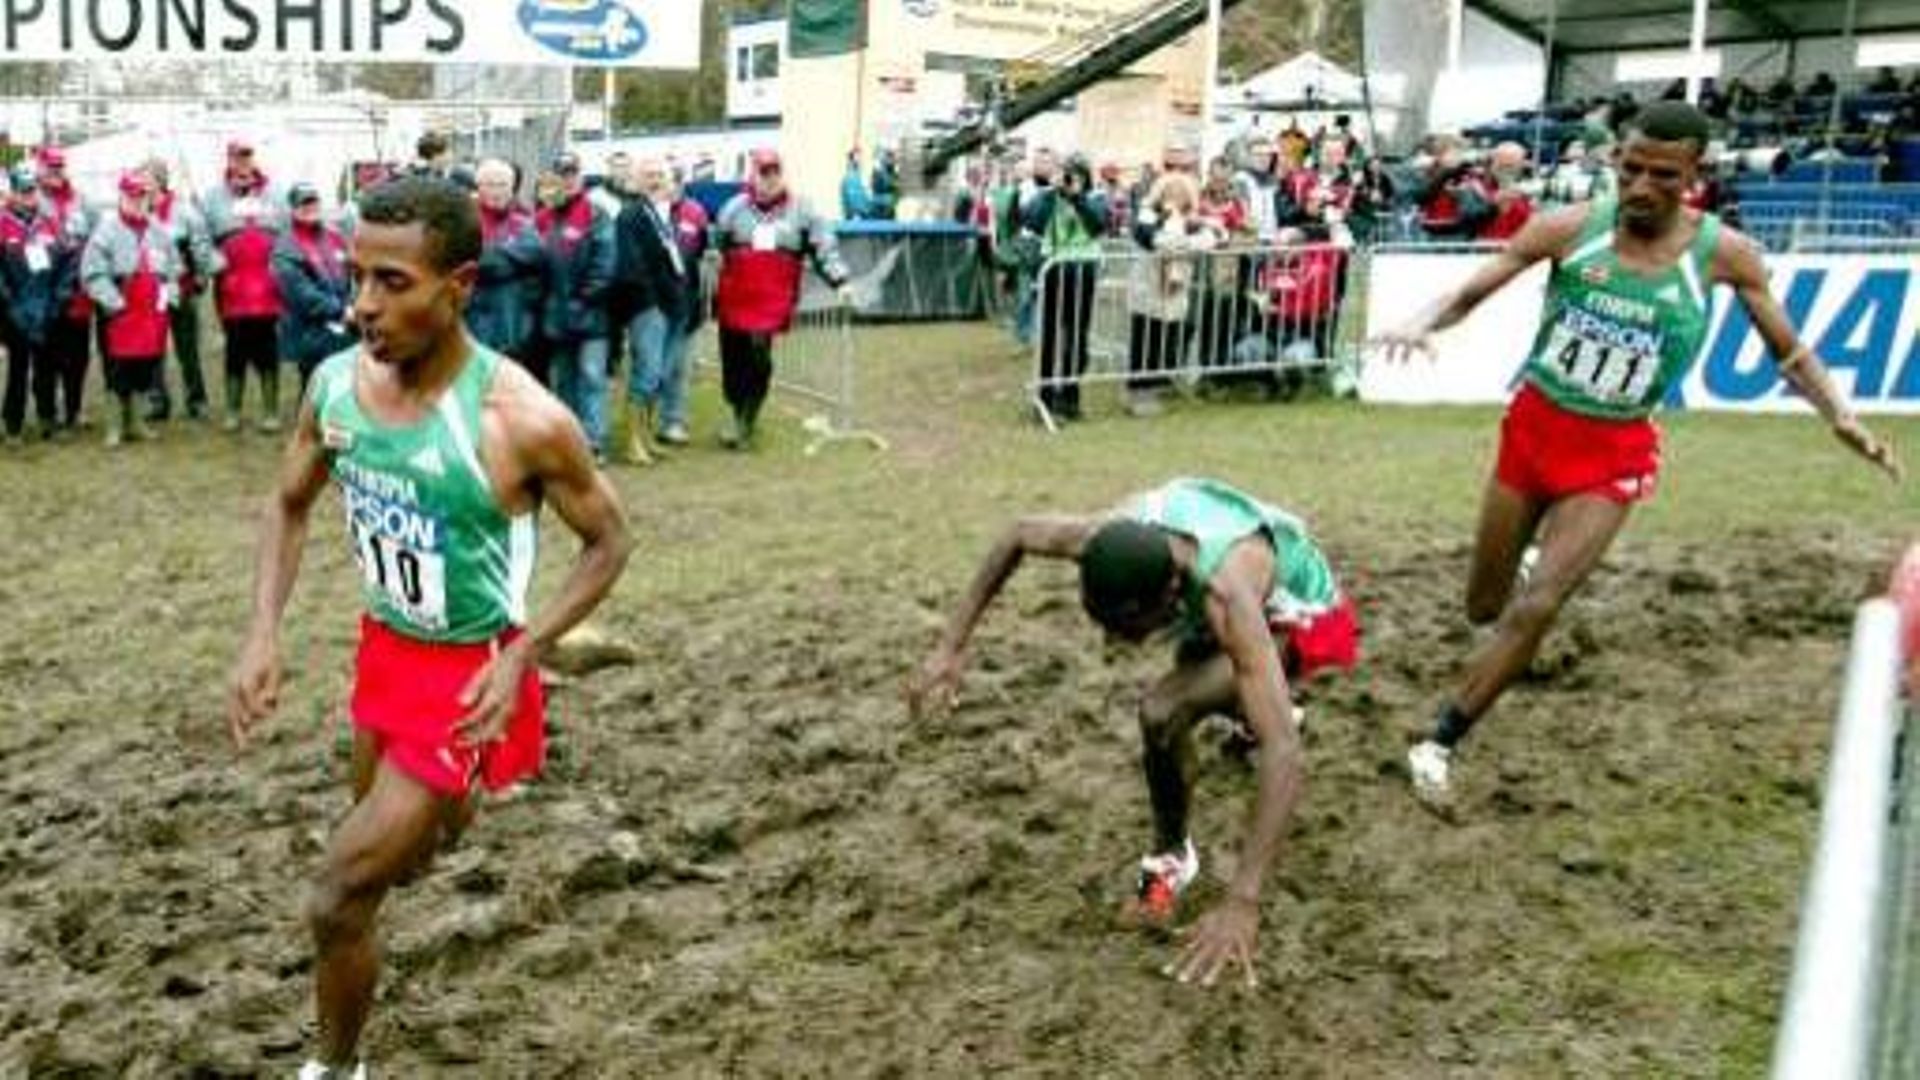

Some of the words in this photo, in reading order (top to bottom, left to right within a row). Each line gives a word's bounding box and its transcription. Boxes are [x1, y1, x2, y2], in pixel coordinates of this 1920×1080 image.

[4, 0, 466, 53] PIONSHIPS
[1563, 305, 1664, 355] EPSON
[1664, 268, 1920, 407] UA
[1557, 337, 1641, 393] 411
[354, 528, 422, 605] 10
